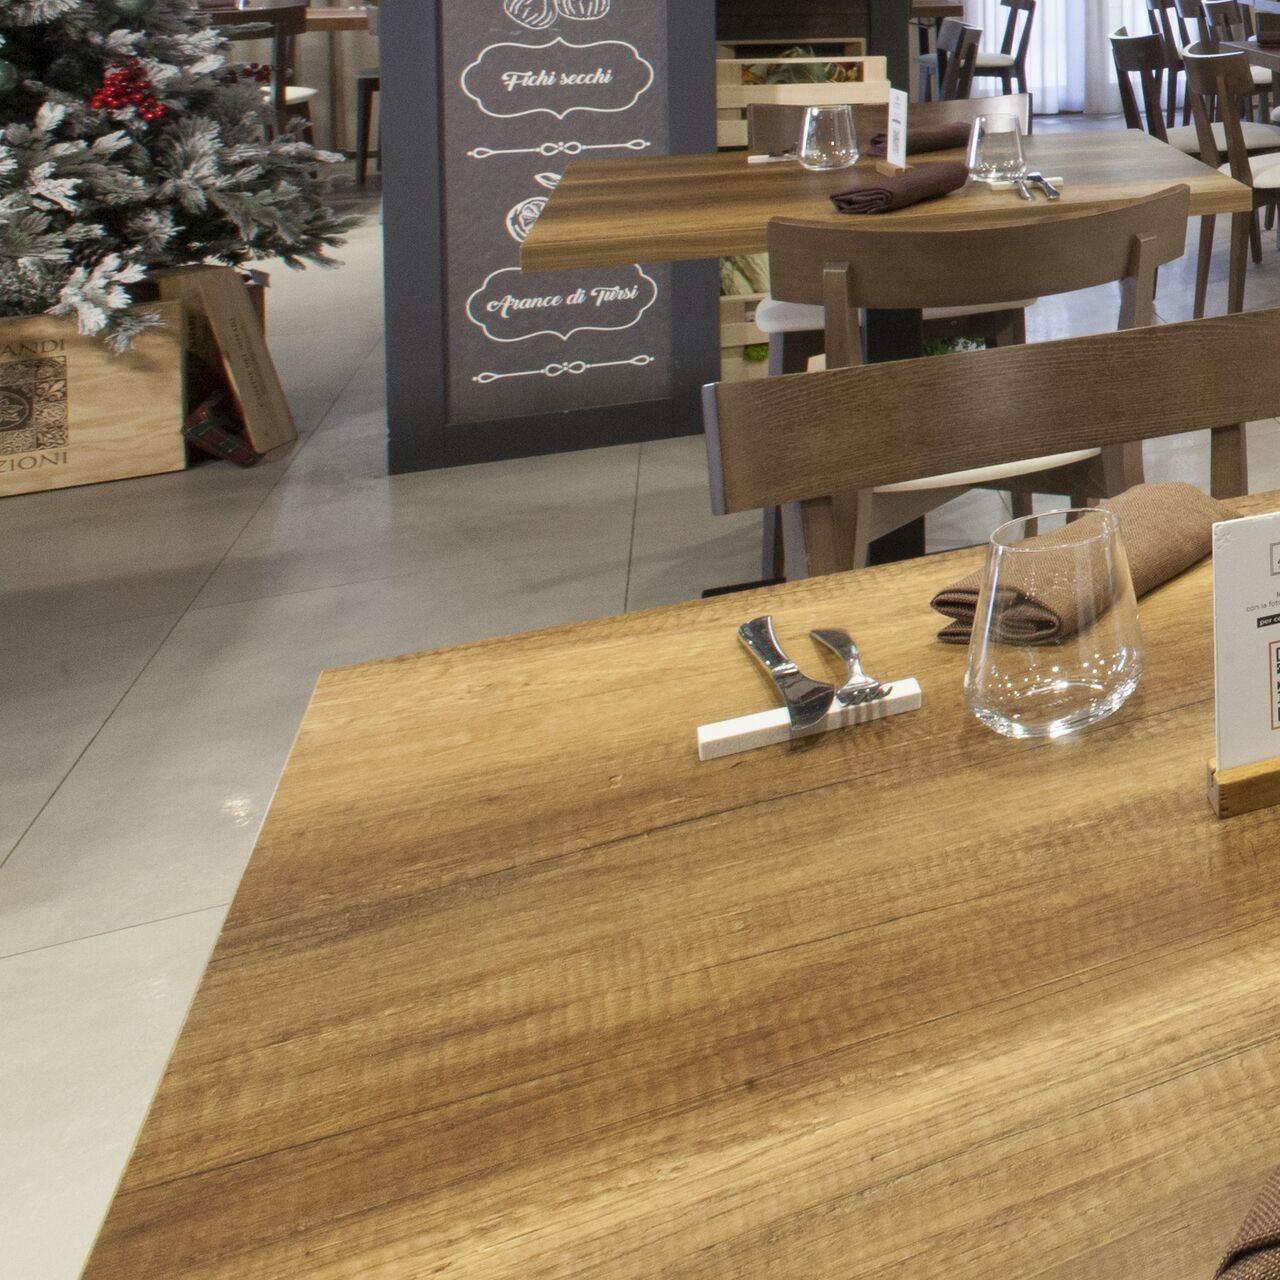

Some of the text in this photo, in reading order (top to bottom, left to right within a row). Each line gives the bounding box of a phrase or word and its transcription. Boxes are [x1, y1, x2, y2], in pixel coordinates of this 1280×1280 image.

[502, 68, 613, 92] Fichi secchi
[487, 284, 639, 318] Arance di Tursi
[1259, 618, 1272, 626] per
